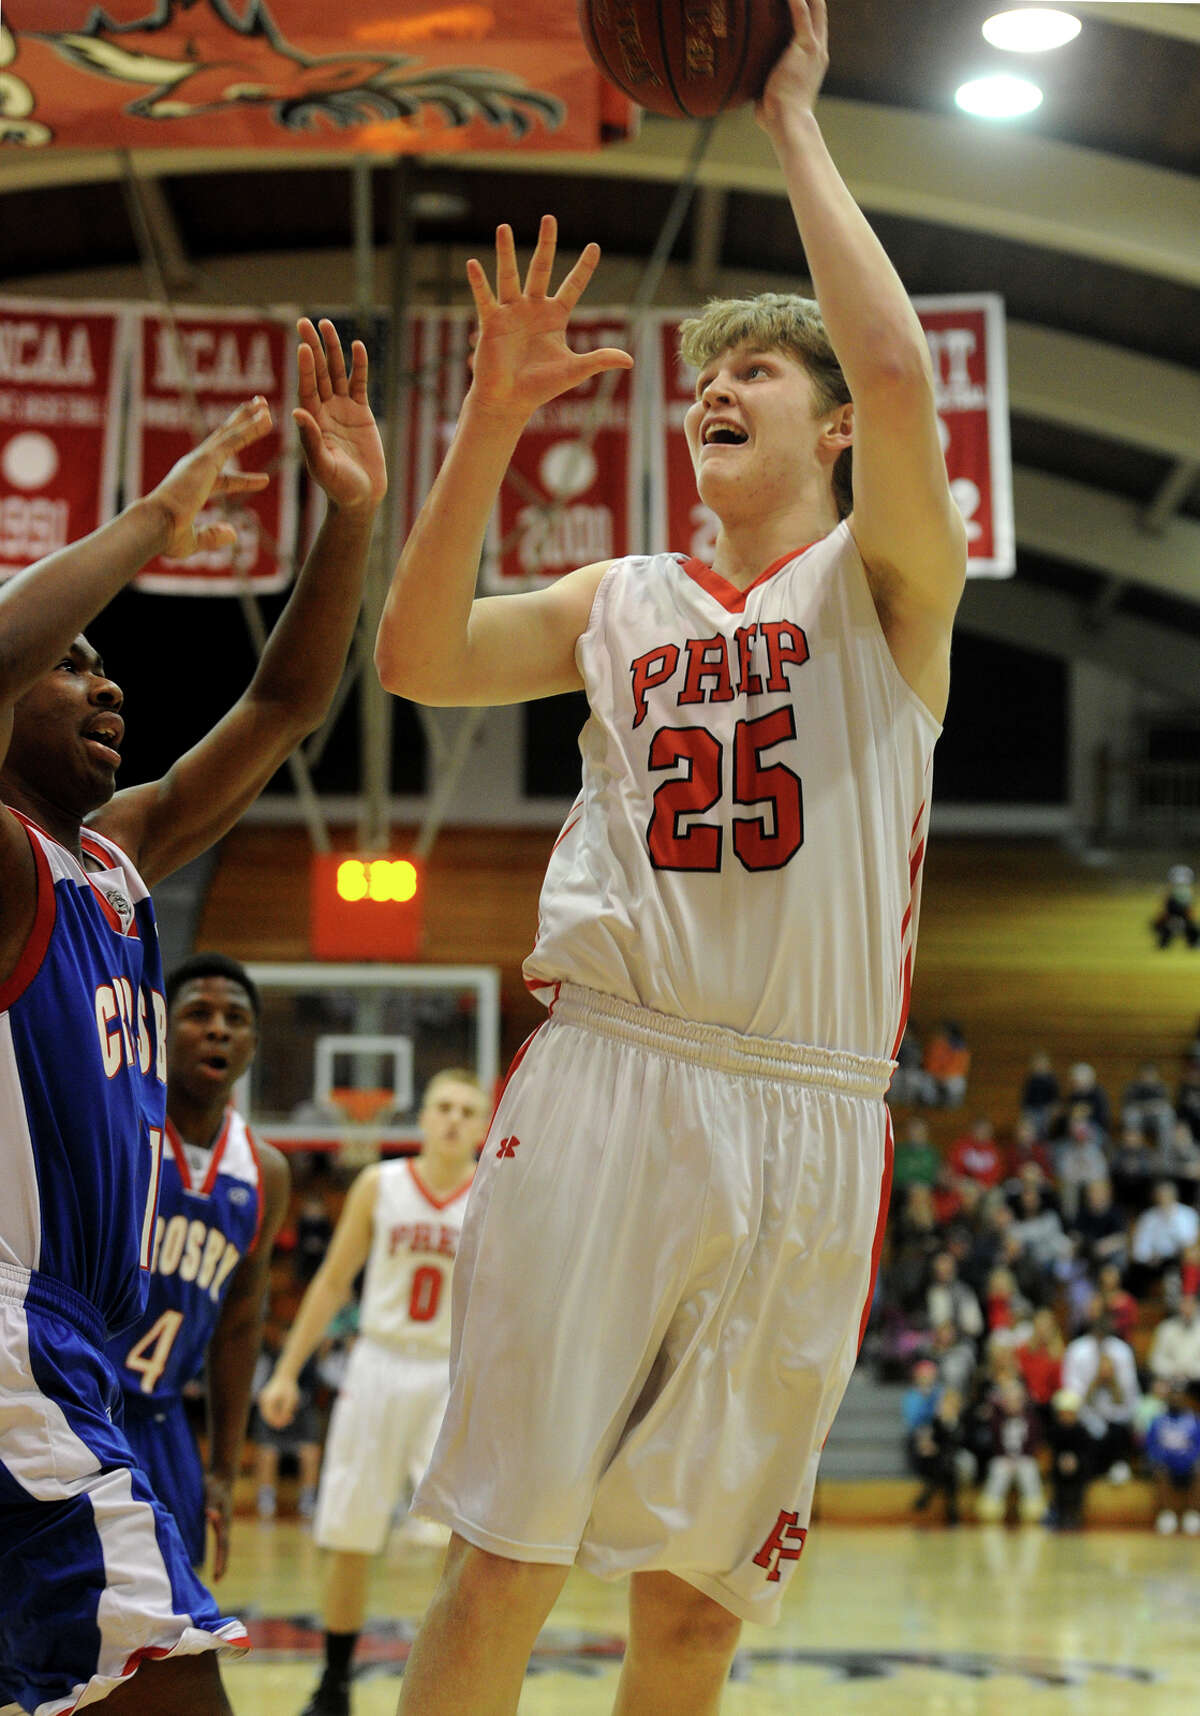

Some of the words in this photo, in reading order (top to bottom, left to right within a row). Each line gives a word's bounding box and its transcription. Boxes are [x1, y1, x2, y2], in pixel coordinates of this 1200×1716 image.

[646, 703, 805, 873] 25
[408, 1265, 444, 1322] 0
[125, 1308, 185, 1395] 4
